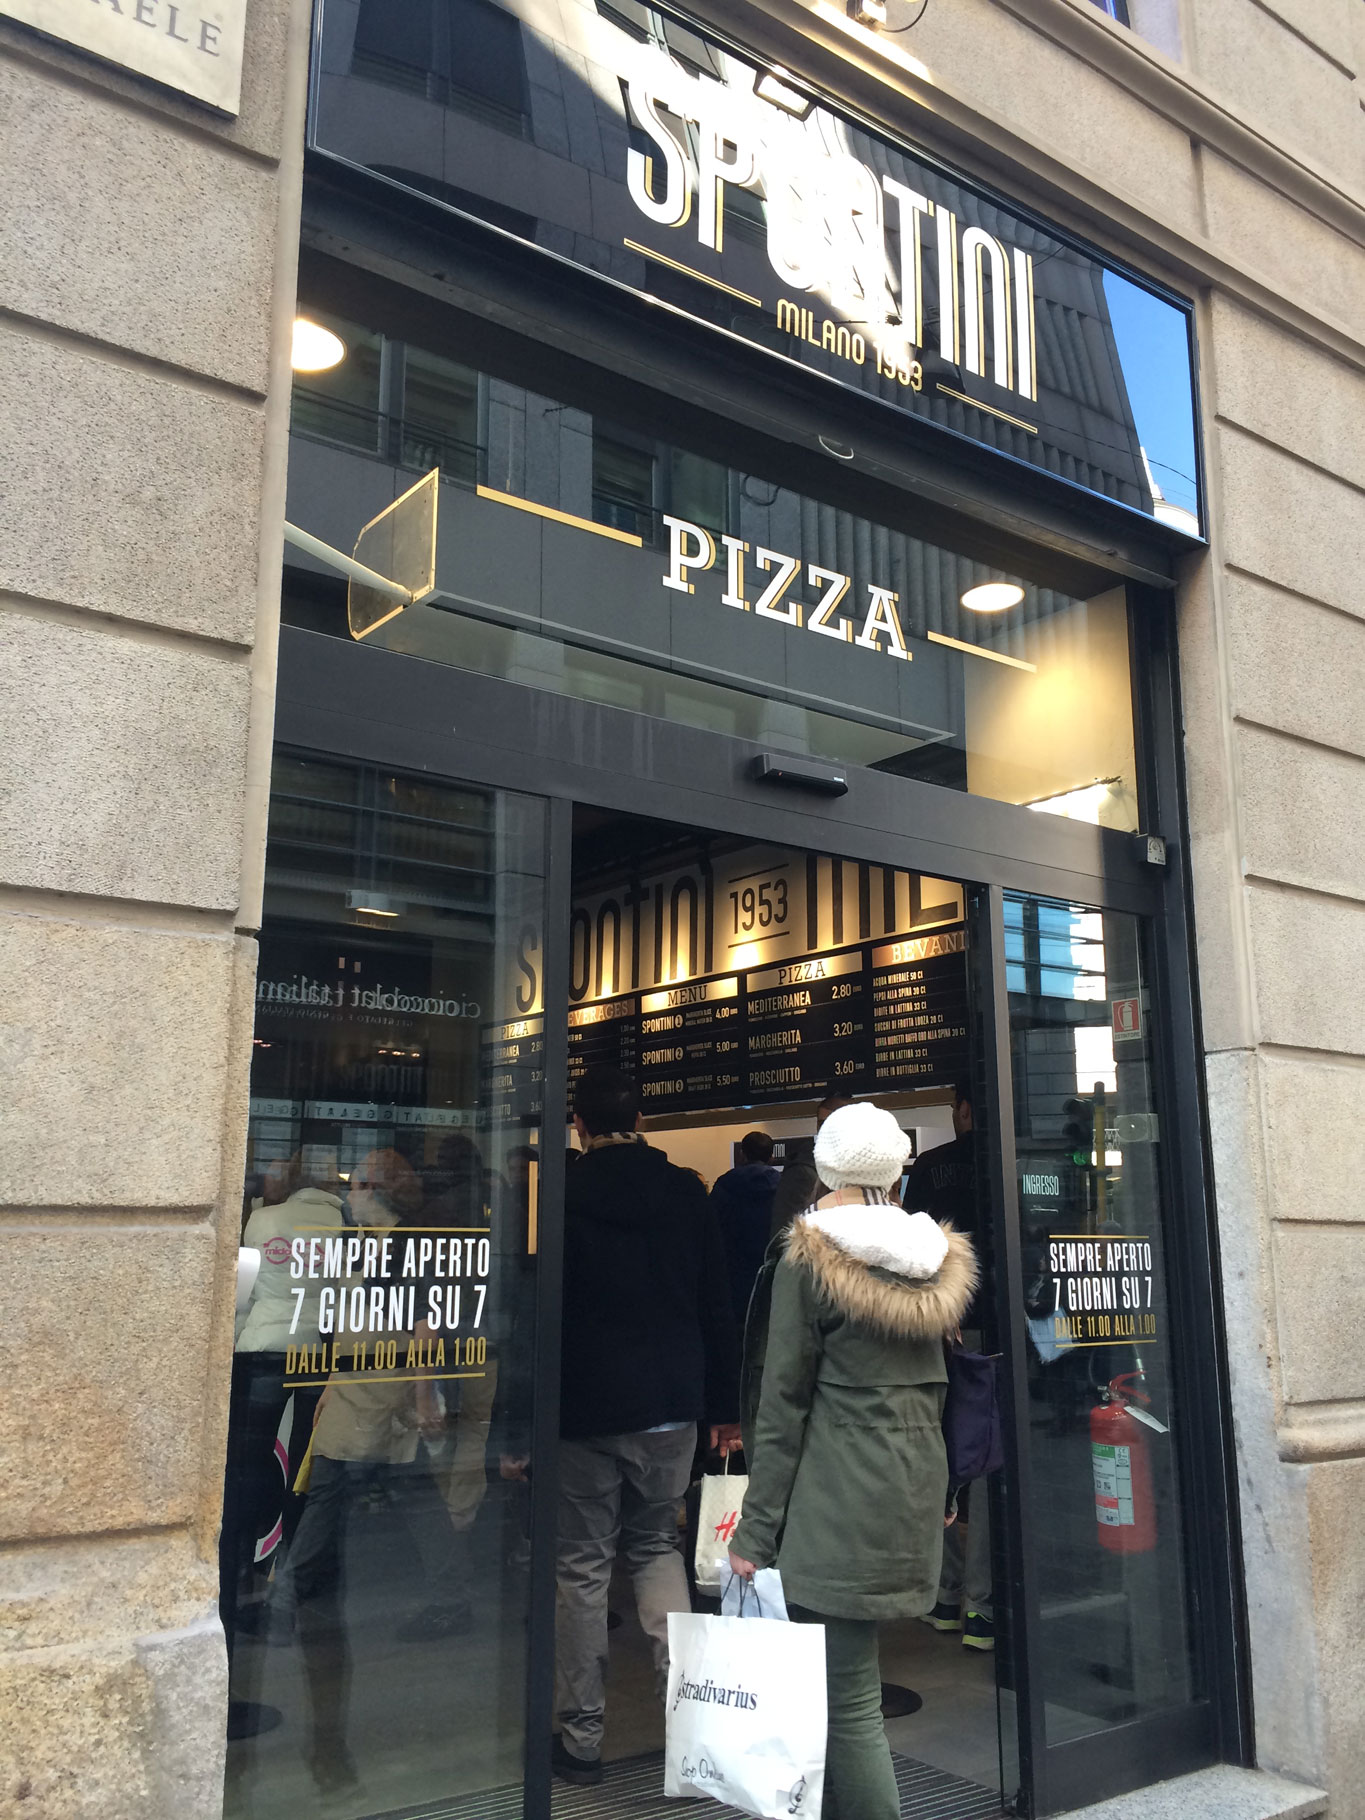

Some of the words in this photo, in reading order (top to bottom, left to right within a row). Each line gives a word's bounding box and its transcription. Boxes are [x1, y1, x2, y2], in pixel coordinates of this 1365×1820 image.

[776, 298, 866, 366] MILANO
[662, 514, 913, 661] PIZZA
[729, 878, 789, 935] 1953
[515, 866, 714, 1014] SONTINI
[892, 930, 967, 963] BEVAN
[778, 961, 826, 985] PIZZA
[668, 985, 708, 1007] MENU
[748, 990, 812, 1016] MEDITERRANEA
[567, 1000, 629, 1024] EVERAGES
[642, 1015, 675, 1034] SPONTINI
[500, 1022, 530, 1040] PIZZA
[748, 1029, 802, 1051] MARGHERITA
[642, 1048, 675, 1066] SPONTINI
[642, 1081, 675, 1097] SPONTINI
[749, 1066, 801, 1087] PROSCIUTTO
[1022, 1173, 1060, 1197] INGRESSO
[290, 1237, 394, 1279] SEMPRE
[402, 1237, 491, 1278] APERTO
[1049, 1242, 1102, 1273] SEMPRE
[1107, 1242, 1152, 1272] APERTO
[1052, 1278, 1061, 1312] 7
[1067, 1277, 1118, 1311] GIORNI
[1121, 1276, 1141, 1309] SU
[1144, 1276, 1152, 1308] 7
[288, 1287, 305, 1335] 7
[318, 1285, 415, 1334] GIORNI
[427, 1284, 461, 1331] SU
[473, 1284, 487, 1329] 7
[1054, 1316, 1083, 1339] DALLE
[1087, 1315, 1111, 1338] 11.00
[1114, 1314, 1136, 1336] ALLA
[1138, 1313, 1156, 1335] 1.00
[285, 1341, 341, 1375] DALLE
[352, 1339, 397, 1372] 11.00
[405, 1337, 445, 1369] ALLA
[454, 1336, 487, 1367] 1.00
[680, 1679, 758, 1711] stradivarius
